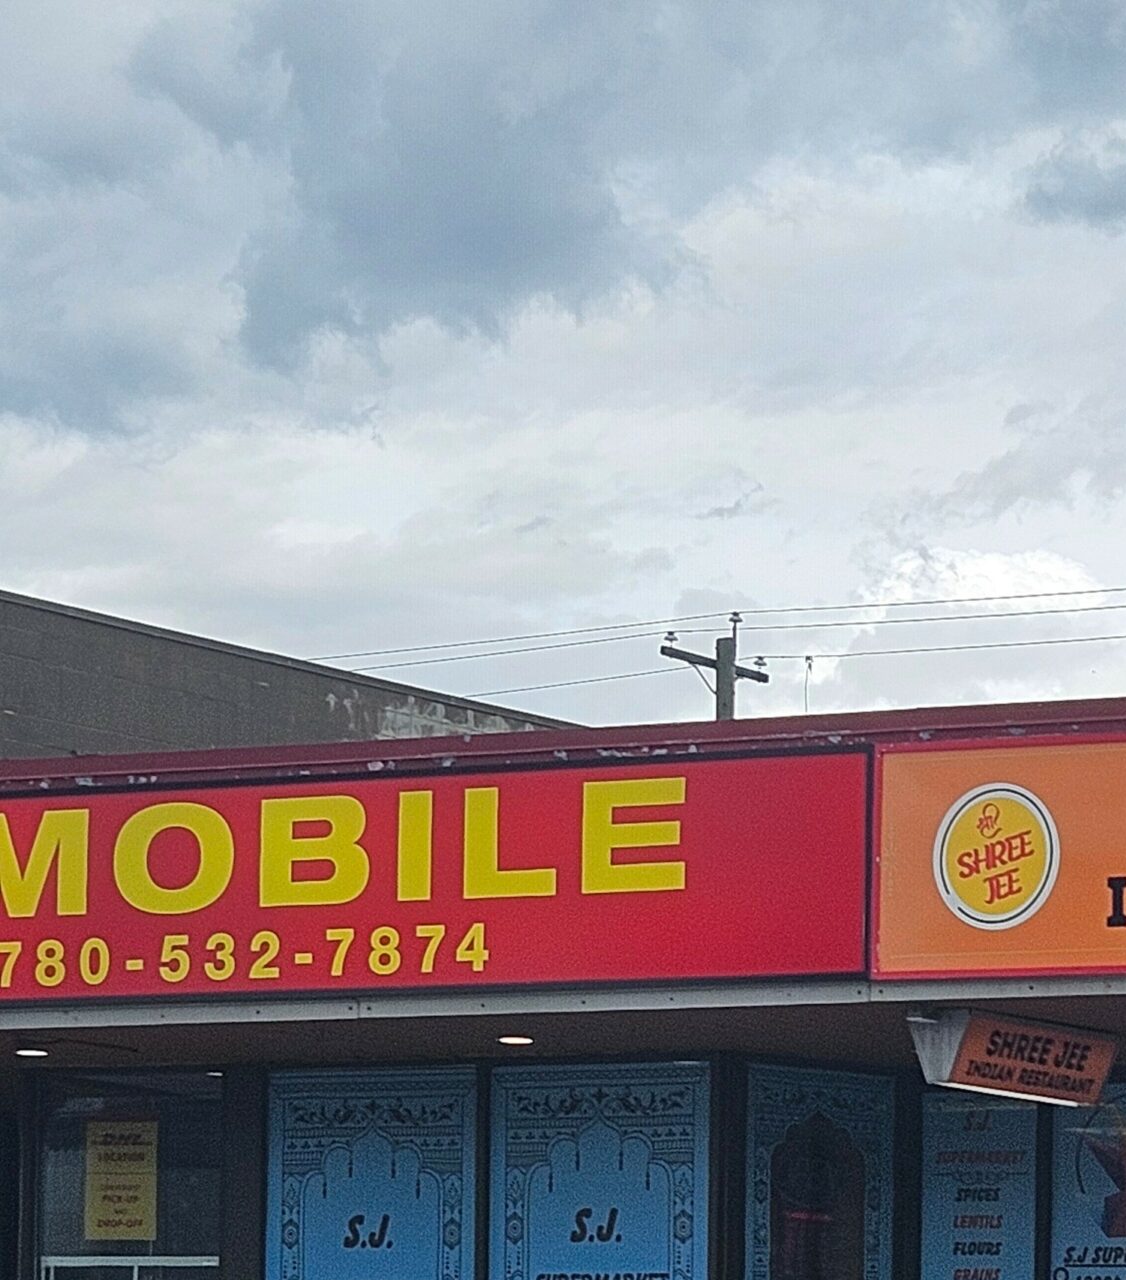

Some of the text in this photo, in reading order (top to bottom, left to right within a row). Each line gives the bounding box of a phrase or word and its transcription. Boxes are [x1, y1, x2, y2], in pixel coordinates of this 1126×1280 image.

[0, 777, 686, 918] MOBILE
[957, 829, 1035, 878] SHREE
[983, 867, 1023, 904] JEE
[0, 922, 489, 989] 780-532-7874
[985, 1030, 1092, 1072] SHREE JEE
[965, 1059, 1095, 1094] INDIAN RESTAURANT
[955, 1187, 1001, 1202] SPICES
[343, 1214, 393, 1248] S.J.
[570, 1208, 622, 1243] S.J.
[953, 1215, 1003, 1229] LENTILS
[952, 1241, 1003, 1256] FLOURS
